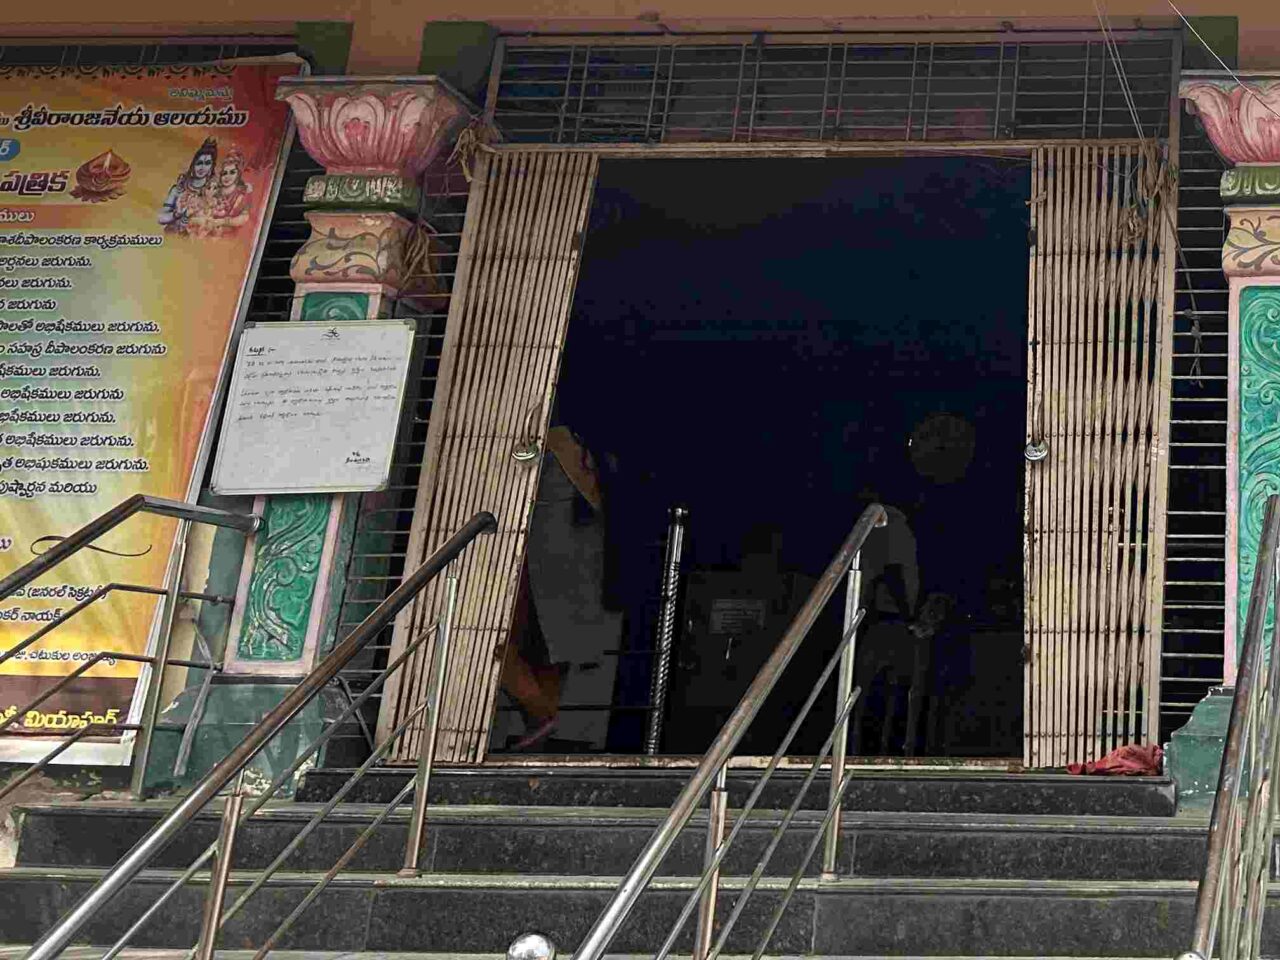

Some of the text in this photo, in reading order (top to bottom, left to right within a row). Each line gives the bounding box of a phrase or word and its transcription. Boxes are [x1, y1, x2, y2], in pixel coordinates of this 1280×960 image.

[14, 105, 149, 130] శ్రీవీరాంజనేయ
[153, 105, 247, 126] ఆలయము
[0, 232, 163, 249] శదీపాలంకరణ కార్యక్రమములు
[41, 256, 92, 267] జరుగును.
[21, 278, 73, 289] జరుగును.
[7, 299, 57, 310] జరుగును
[35, 319, 105, 334] అభిషేకములు
[108, 321, 160, 333] జరుగును.
[7, 342, 43, 357] సహస్ర
[45, 340, 114, 354] దీపాలంకరణ
[116, 343, 166, 355] జరుగును
[49, 365, 101, 377] జరుగును.
[1, 386, 124, 401] అభిషేకములు జరుగును
[0, 408, 116, 424] భిషేకములు జరుగును.
[5, 431, 78, 448] అభిషేకములు
[80, 435, 135, 447] జరుగును.
[95, 458, 150, 471] జరుగును.
[48, 481, 98, 494] మరియు
